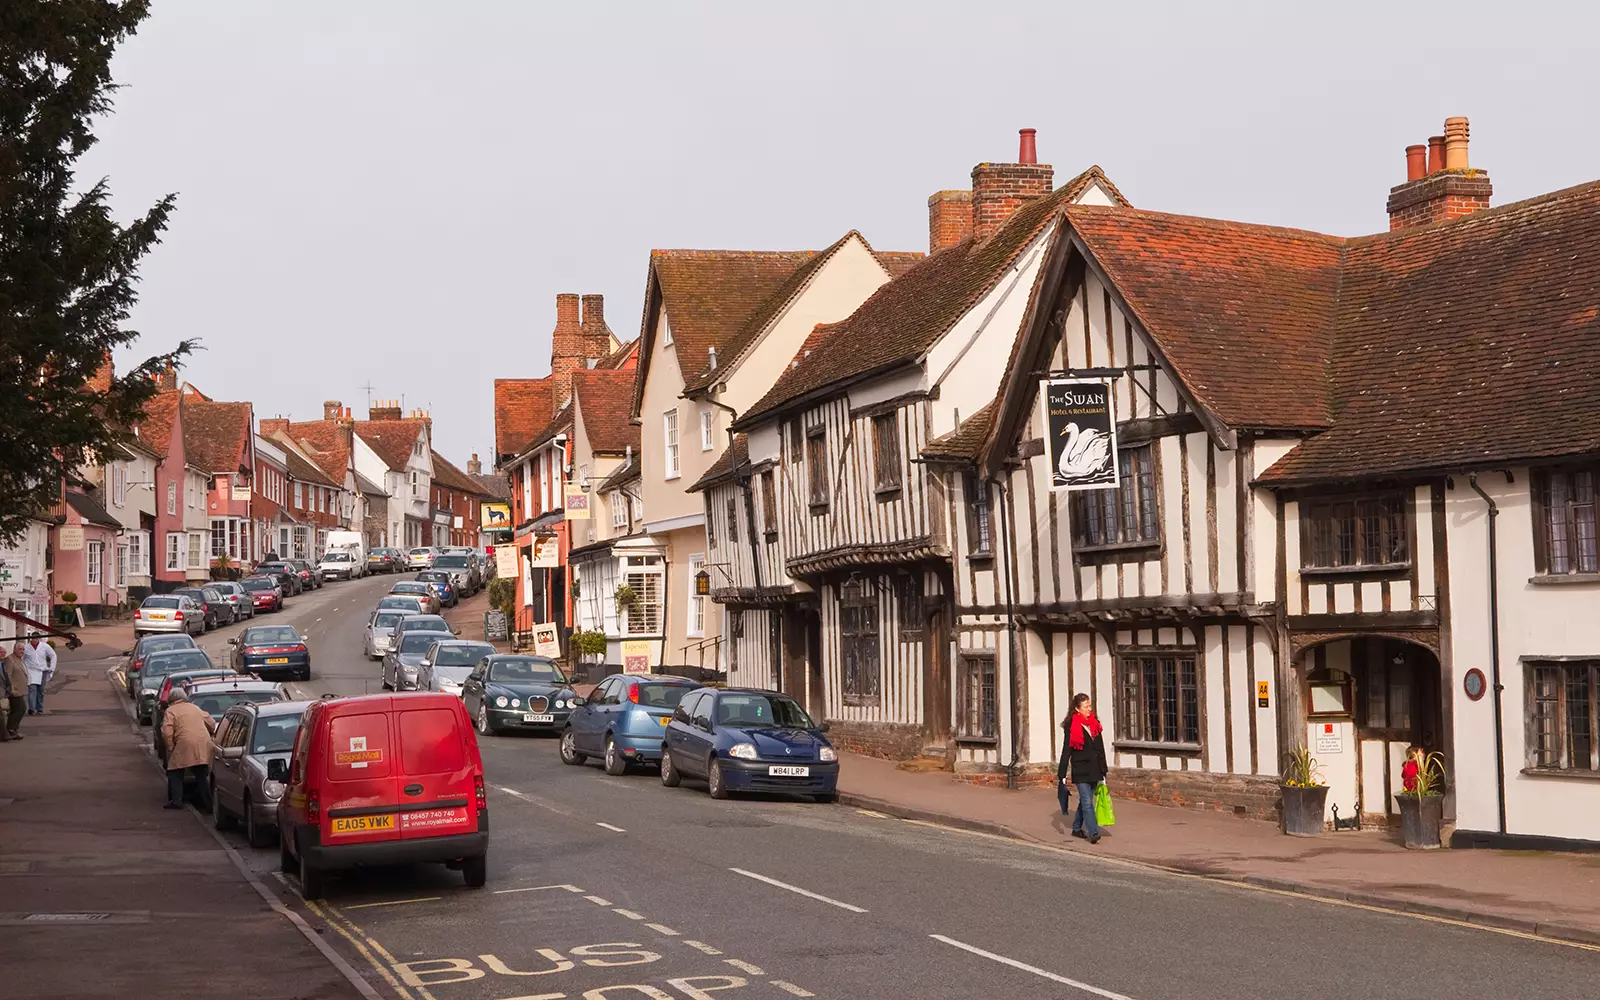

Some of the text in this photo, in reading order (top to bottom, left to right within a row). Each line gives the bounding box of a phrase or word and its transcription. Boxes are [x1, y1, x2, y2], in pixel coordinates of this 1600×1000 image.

[1259, 685, 1268, 694] AA
[339, 751, 380, 763] Royal Mail
[790, 767, 806, 776] LRP
[430, 811, 443, 819] 740
[337, 816, 391, 831] EA05 VWK
[410, 817, 468, 828] www.royalmail.com
[390, 942, 663, 987] BUS
